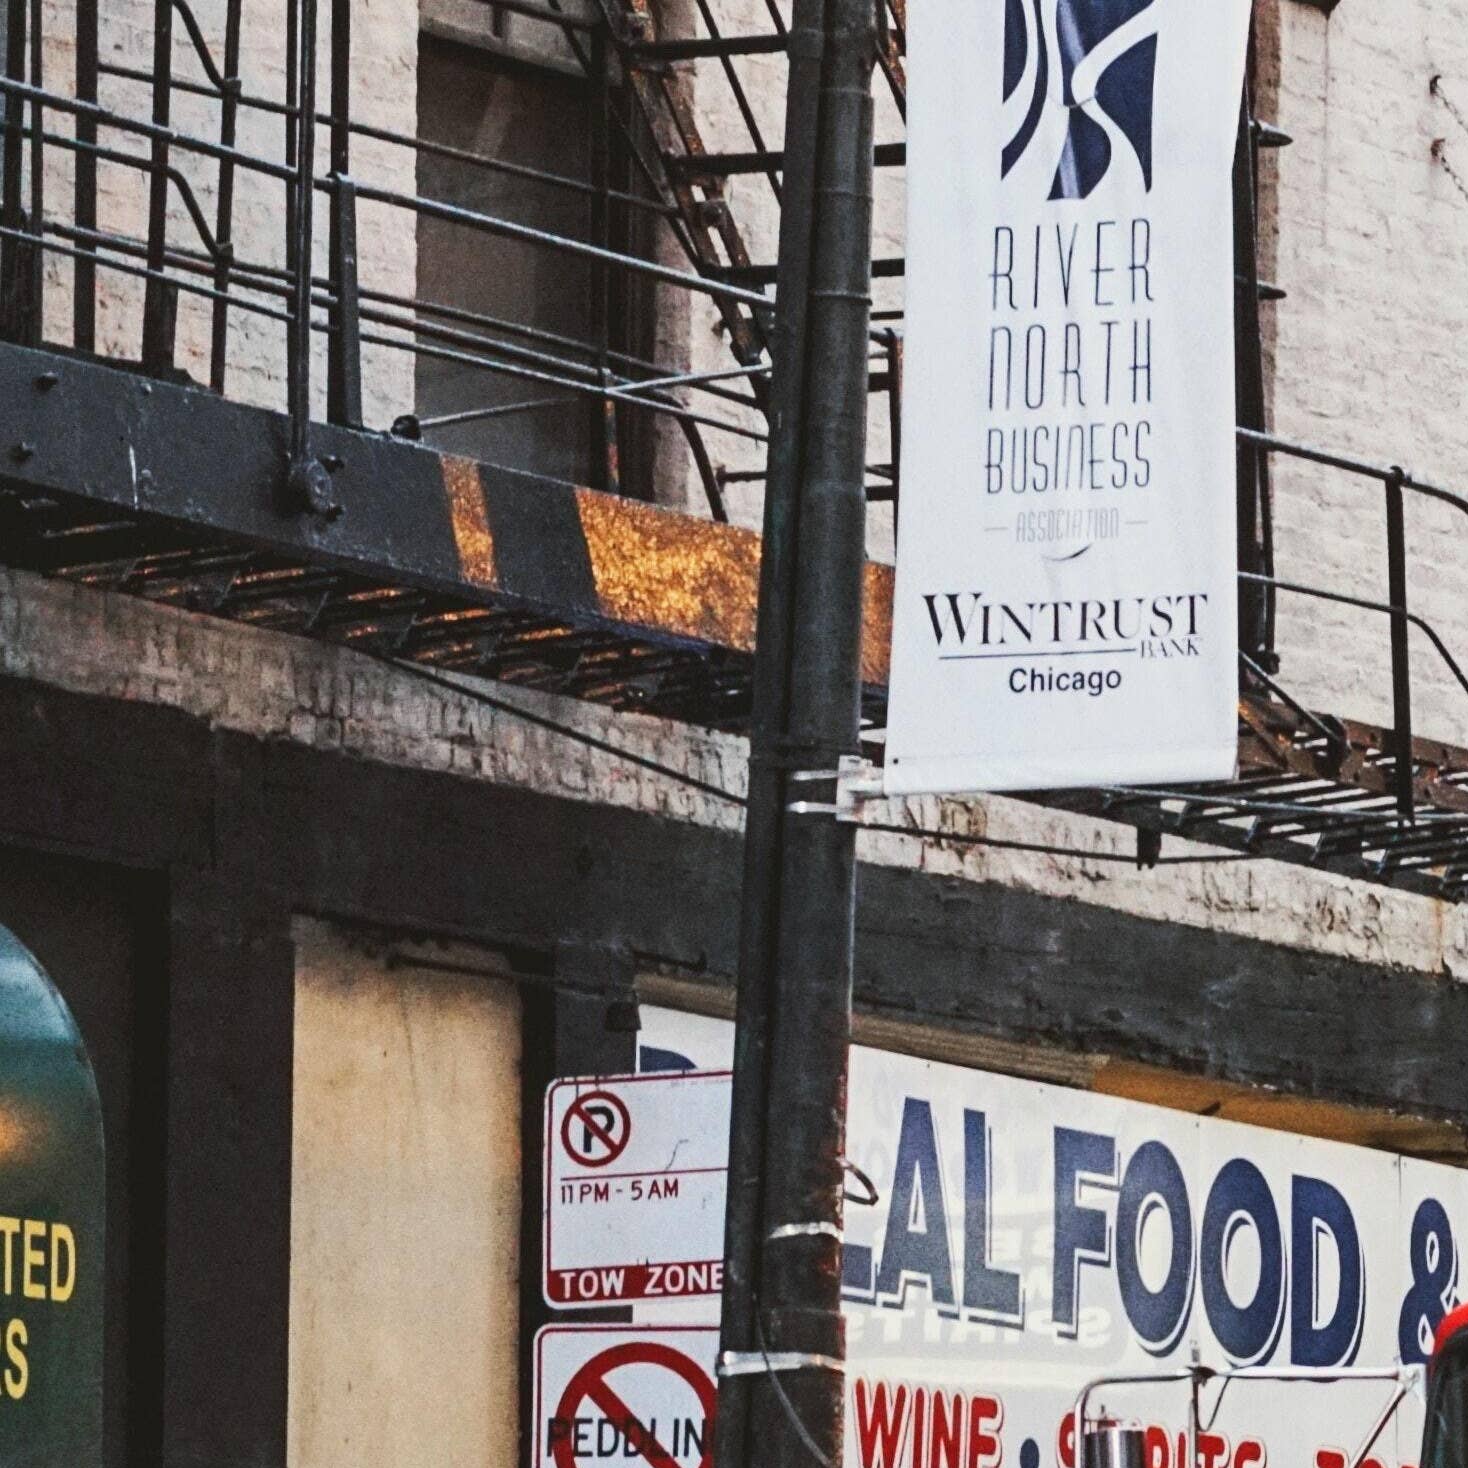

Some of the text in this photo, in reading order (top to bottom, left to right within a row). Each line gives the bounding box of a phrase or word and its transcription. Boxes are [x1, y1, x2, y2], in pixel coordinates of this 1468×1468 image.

[988, 217, 1154, 312] RIVER
[988, 318, 1153, 412] NORTH
[984, 421, 1151, 496] BUSINESS
[922, 593, 1208, 648] WINTRUST
[1139, 637, 1201, 660] BANK
[1008, 665, 1123, 697] Chicago
[579, 1184, 609, 1202] PM
[630, 1182, 644, 1200] 5
[647, 1178, 679, 1200] AM
[1051, 1124, 1367, 1368] FOOD
[1399, 1197, 1460, 1367] &
[560, 1263, 724, 1300] TOW ZONE
[546, 1417, 706, 1459] PEDDLIN
